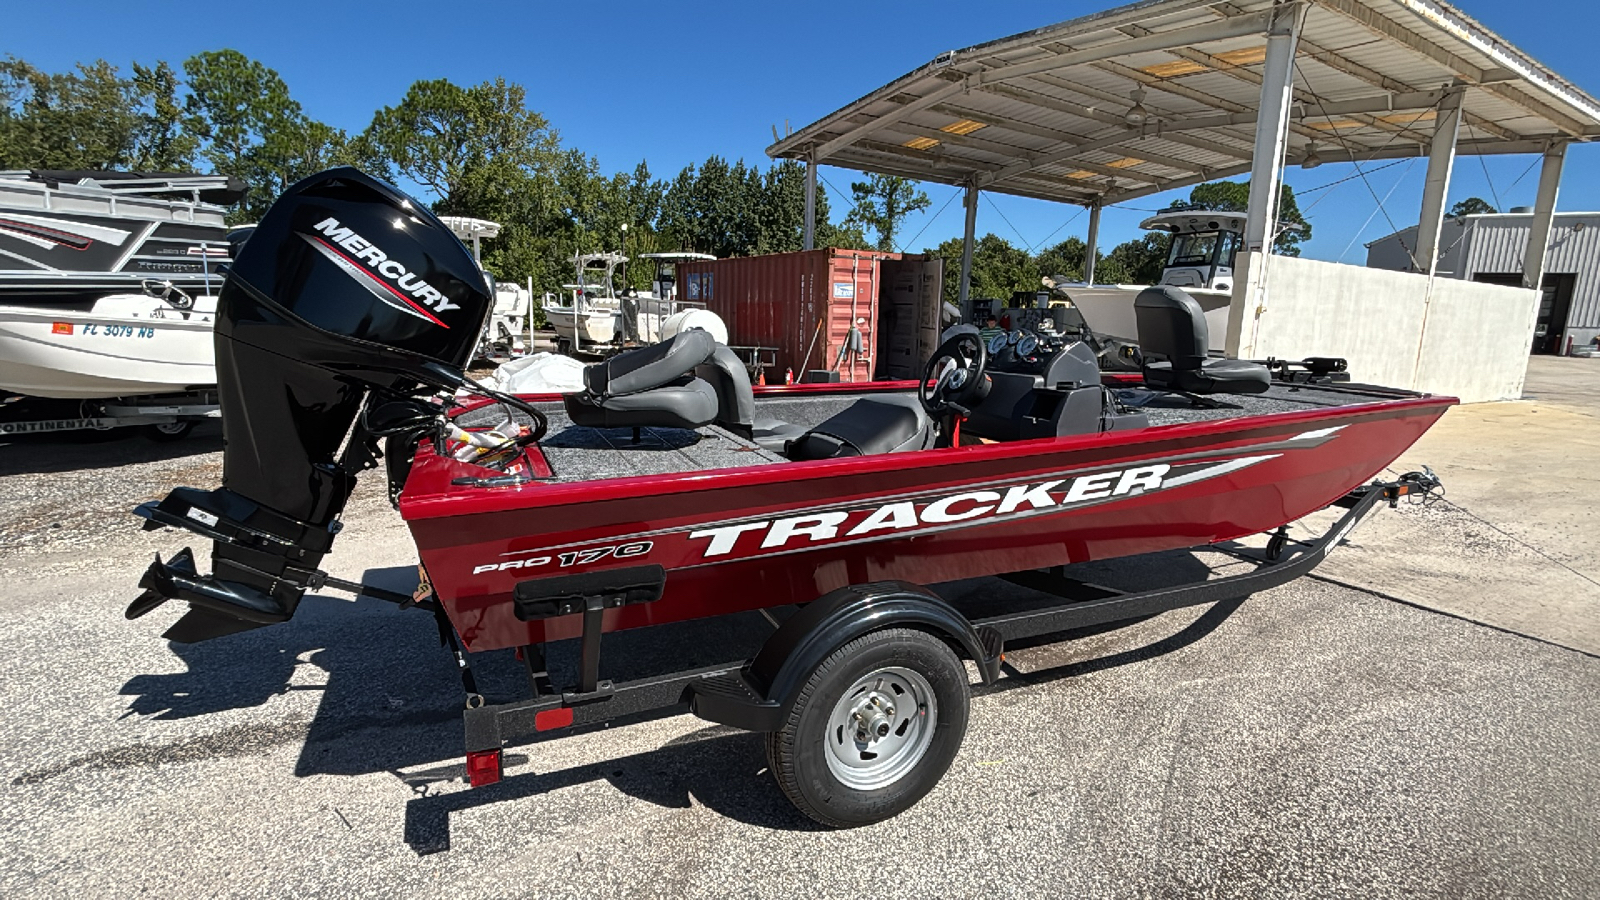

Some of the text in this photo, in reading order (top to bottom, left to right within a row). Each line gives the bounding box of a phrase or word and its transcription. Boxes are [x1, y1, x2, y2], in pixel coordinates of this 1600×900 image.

[313, 217, 461, 313] MERCURY
[82, 323, 98, 335] FL
[103, 324, 133, 337] 3079
[0, 419, 104, 433] ONTINENTAL
[687, 463, 1171, 557] TRACKER
[472, 541, 654, 575] PRO 170
